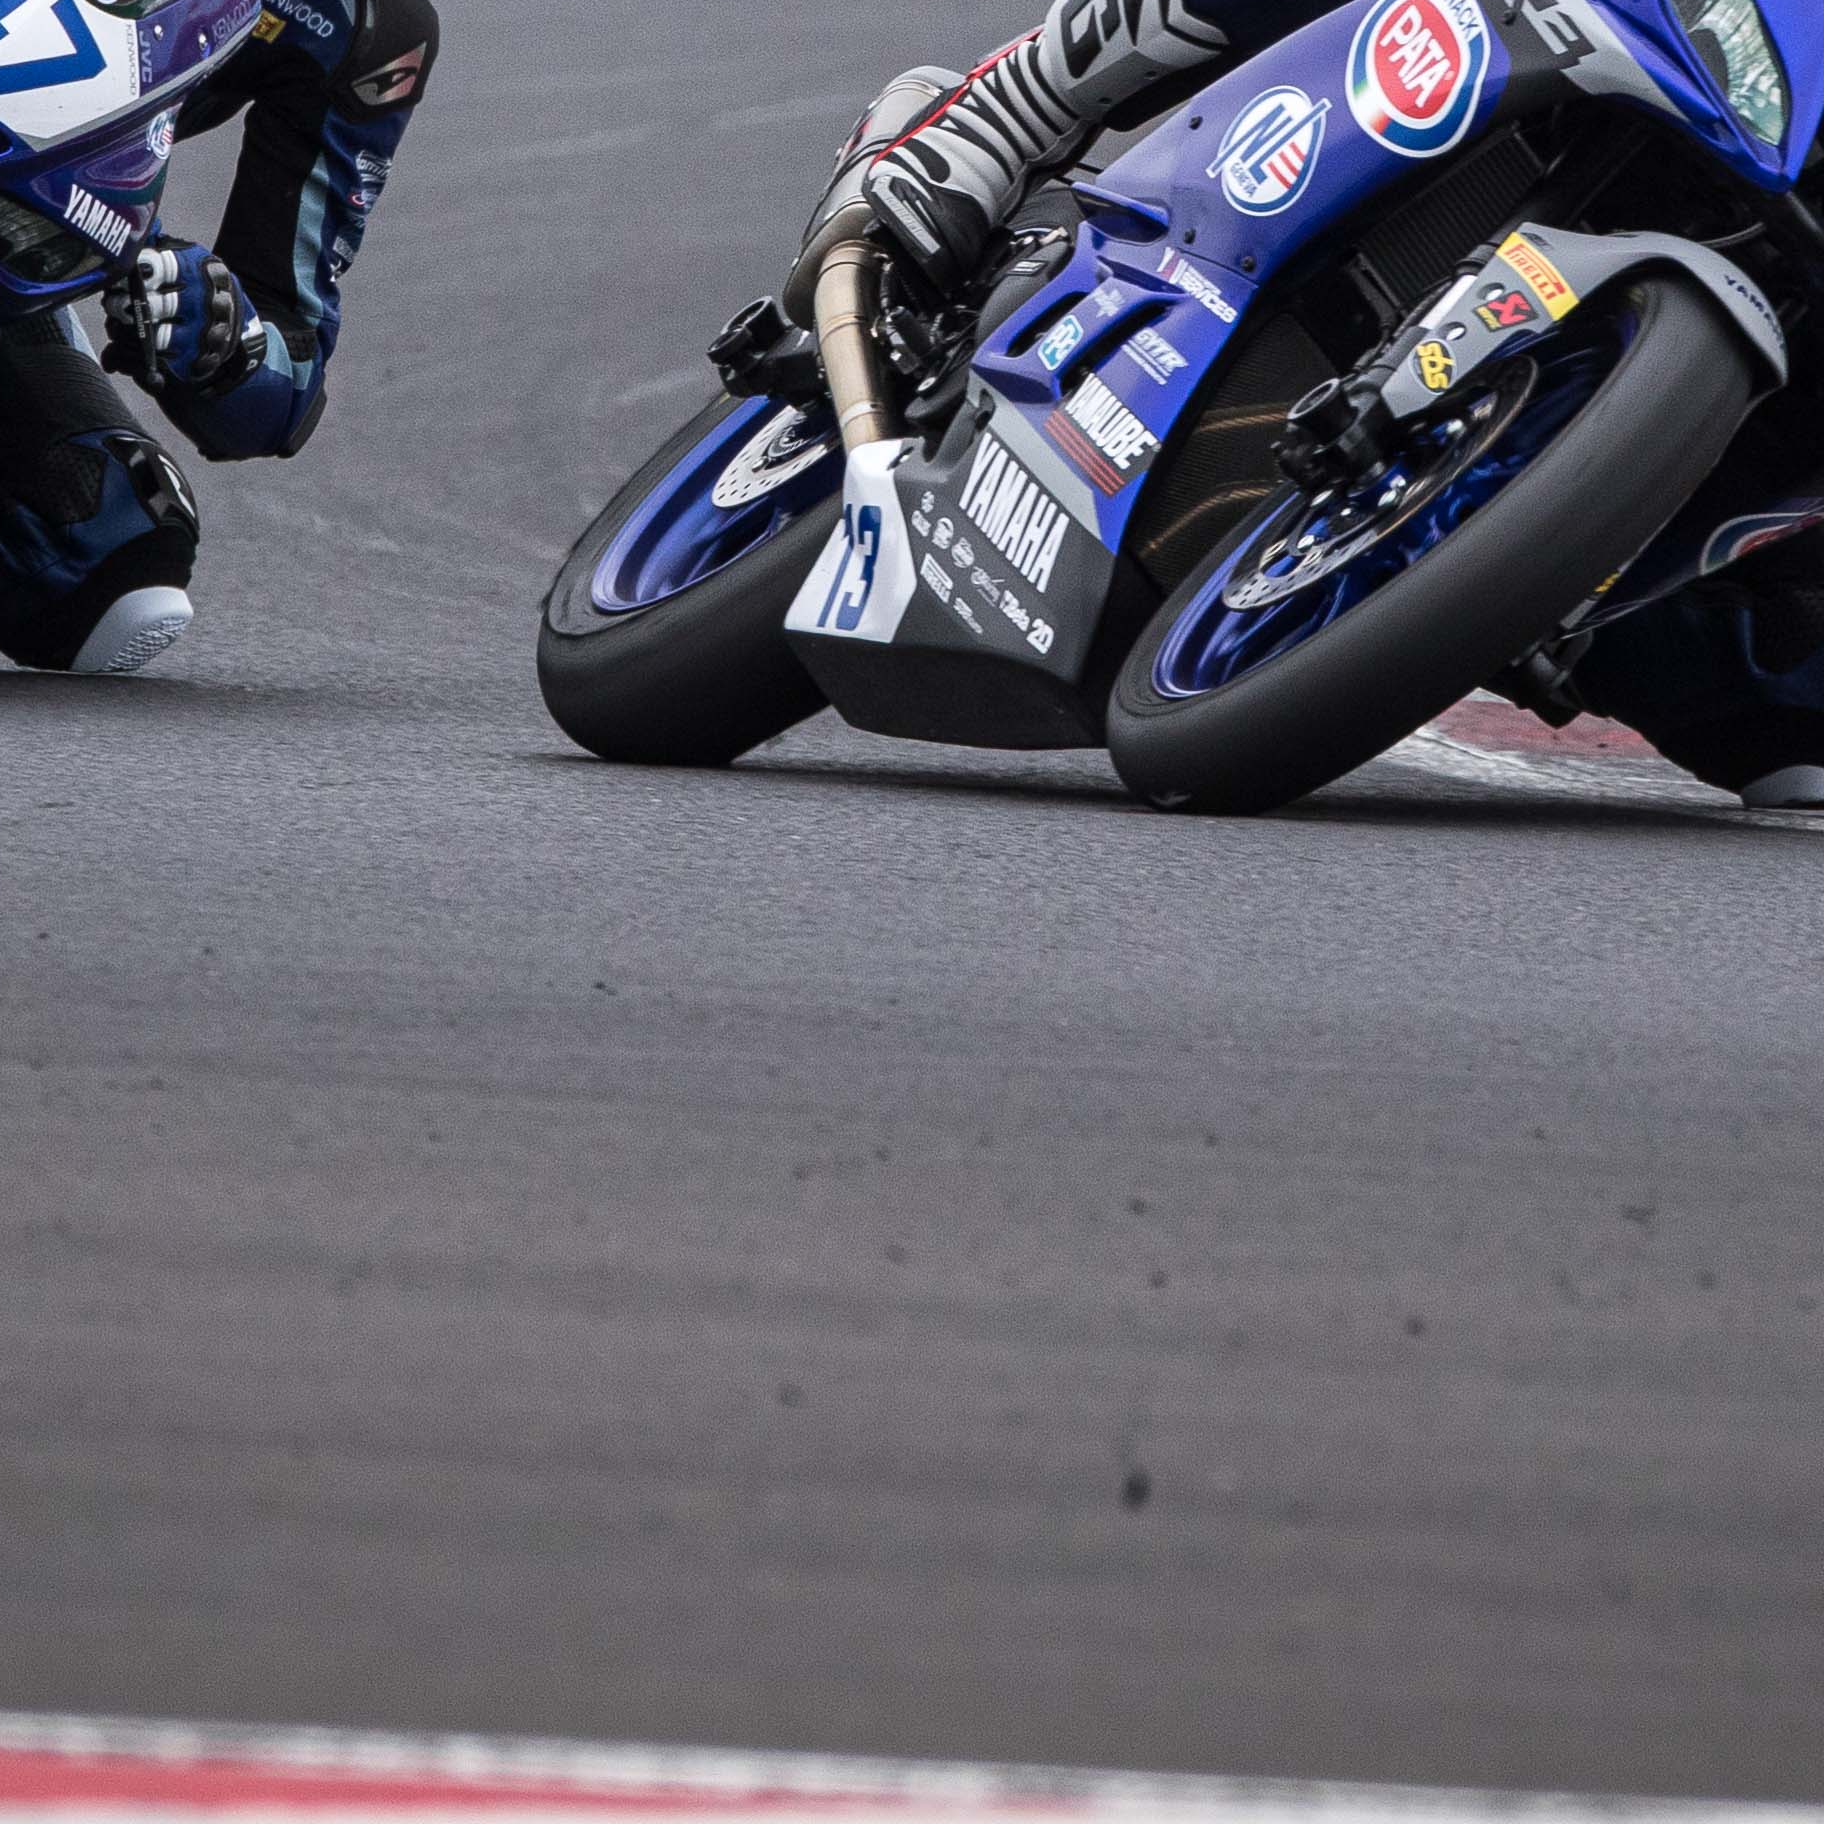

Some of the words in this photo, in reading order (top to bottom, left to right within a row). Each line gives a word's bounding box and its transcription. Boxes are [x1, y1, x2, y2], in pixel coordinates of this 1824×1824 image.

[138, 30, 153, 84] JVC
[1380, 5, 1453, 108] PATA
[63, 183, 133, 257] YAMAHA
[1179, 269, 1238, 324] SERVICES
[1503, 242, 1567, 301] PIRELLI
[1133, 326, 1189, 372] GYTR
[1416, 341, 1457, 390] sbs
[1065, 373, 1158, 470] YAMALUBE
[959, 432, 1071, 594] YAMAHA
